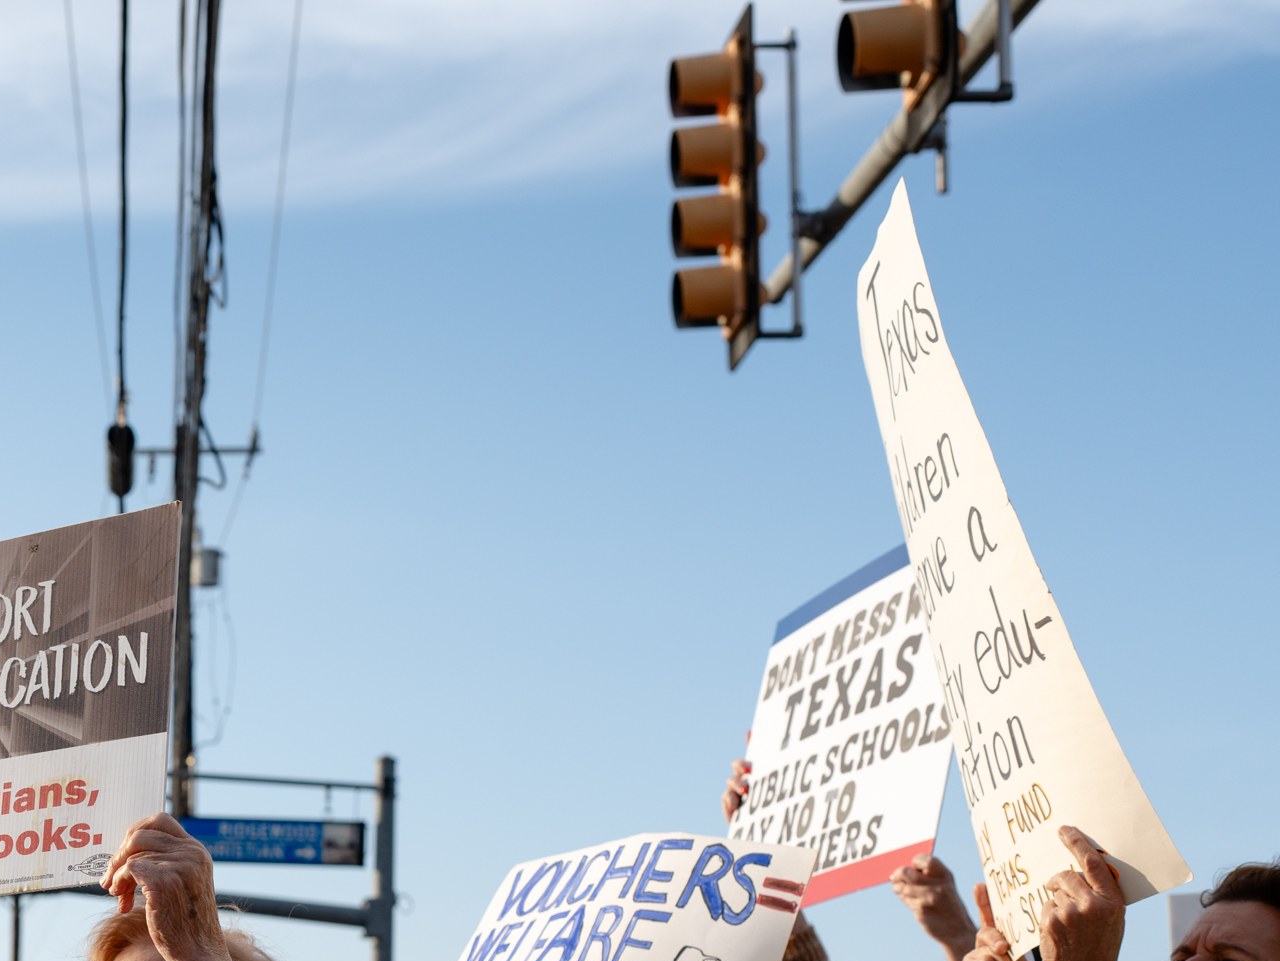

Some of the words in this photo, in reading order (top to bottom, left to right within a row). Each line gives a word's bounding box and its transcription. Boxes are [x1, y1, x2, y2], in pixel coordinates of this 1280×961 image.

[866, 260, 939, 421] Texas
[966, 505, 998, 563] a
[825, 591, 904, 666] MESS
[974, 585, 1053, 694] edu-
[780, 631, 924, 751] TEXAS
[820, 702, 951, 786] SCHOOLS
[961, 715, 1036, 808] ation
[777, 795, 815, 845] NO
[821, 779, 857, 830] TO
[1002, 781, 1053, 845] FUND
[989, 853, 1030, 906] TEXAS
